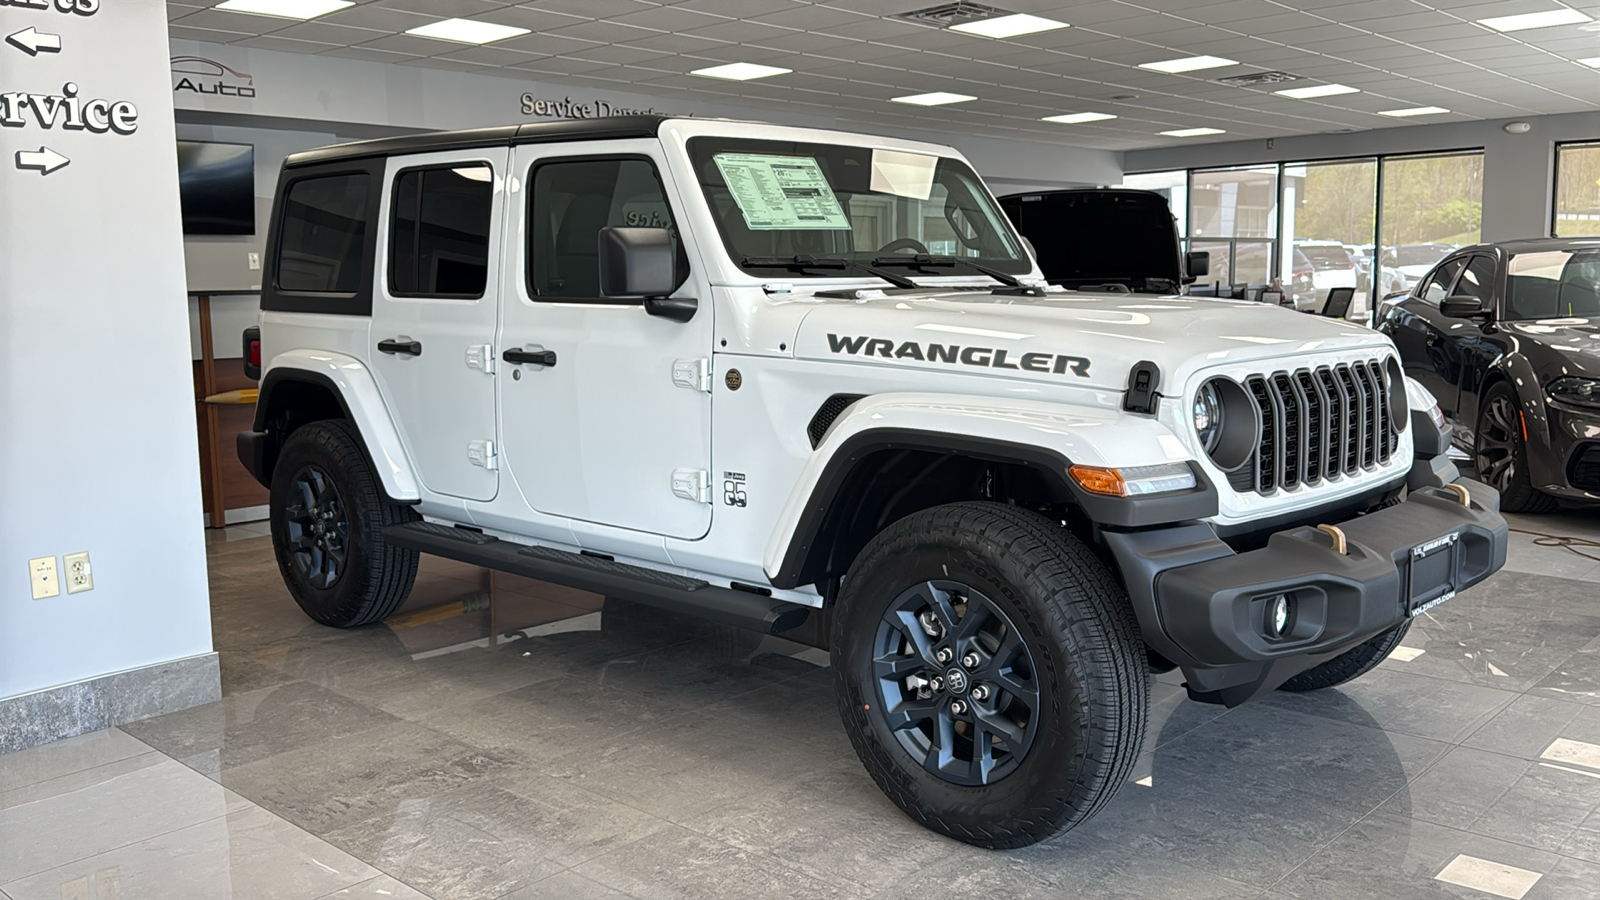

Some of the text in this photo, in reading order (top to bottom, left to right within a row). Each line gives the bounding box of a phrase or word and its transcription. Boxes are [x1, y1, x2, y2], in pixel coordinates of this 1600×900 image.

[174, 78, 256, 98] Auto
[0, 82, 138, 136] rvice
[520, 92, 592, 119] Service
[827, 333, 1091, 378] WRANGLER
[724, 480, 747, 508] 85
[961, 559, 1042, 638] ROADIAN
[1411, 591, 1456, 617] VOLZAUTO.COM
